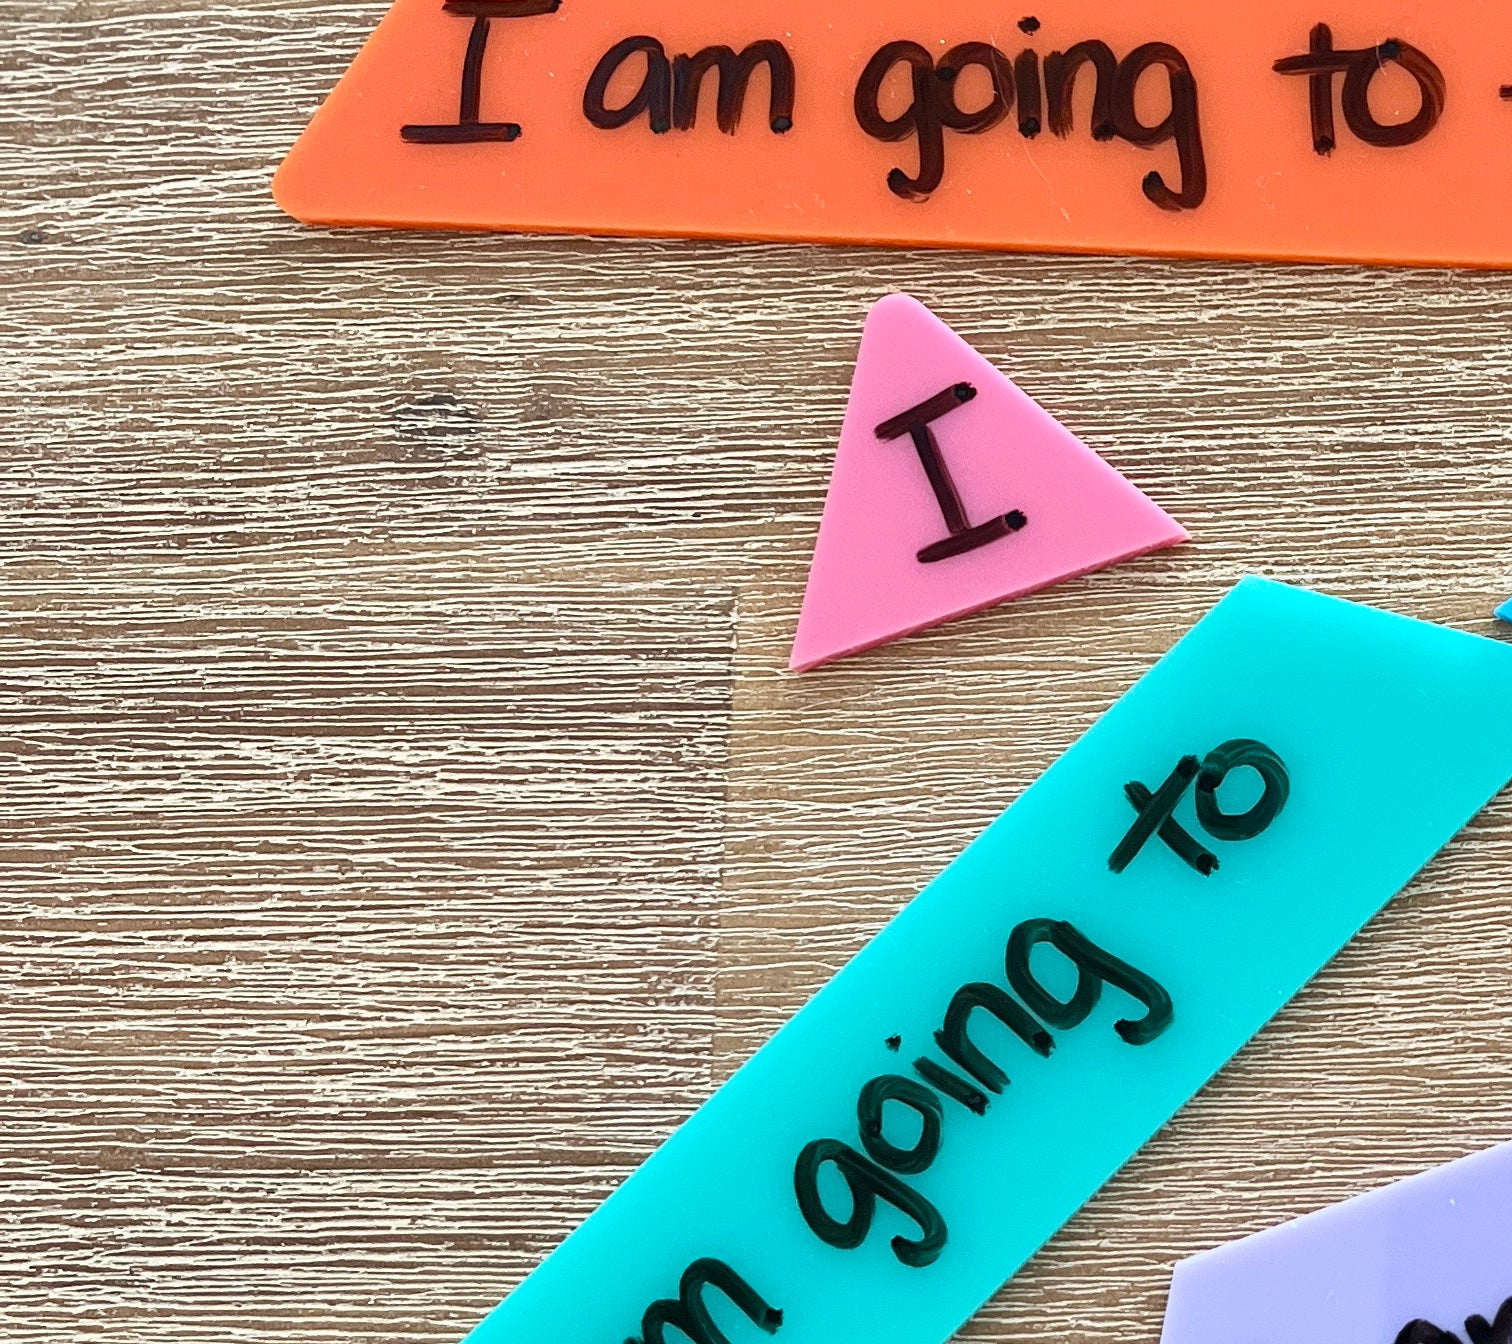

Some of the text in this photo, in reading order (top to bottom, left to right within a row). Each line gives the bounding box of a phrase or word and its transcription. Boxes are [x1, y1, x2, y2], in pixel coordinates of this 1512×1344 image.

[583, 36, 795, 136] am
[854, 16, 1207, 211] going
[1272, 23, 1444, 157] to
[874, 382, 1027, 564] I
[793, 917, 1174, 1268] going
[1108, 739, 1290, 877] to
